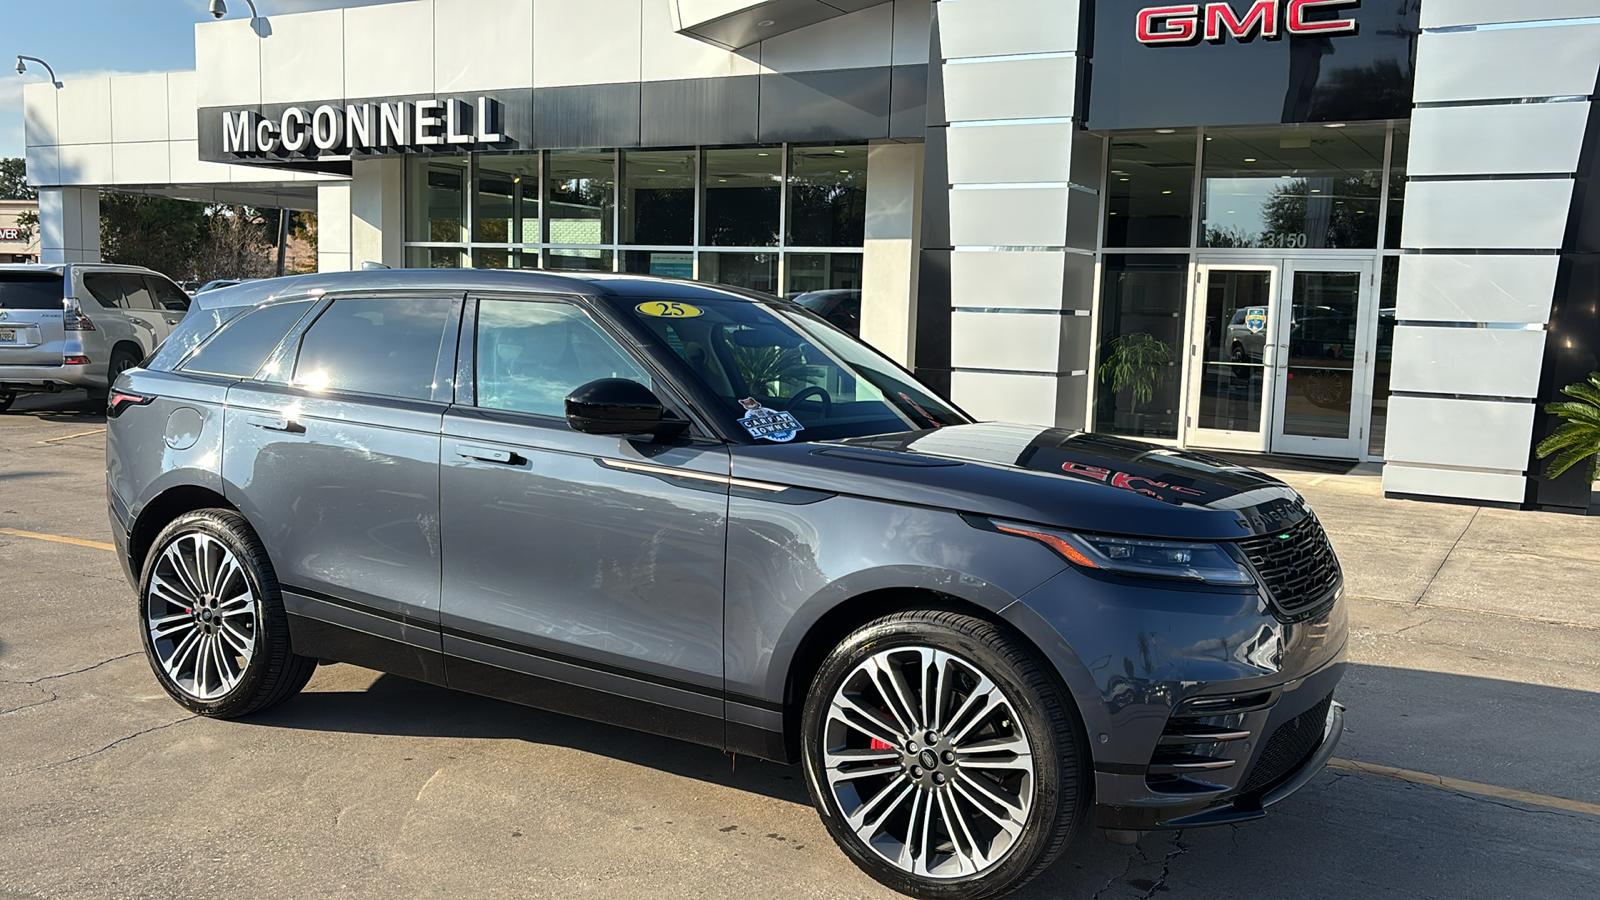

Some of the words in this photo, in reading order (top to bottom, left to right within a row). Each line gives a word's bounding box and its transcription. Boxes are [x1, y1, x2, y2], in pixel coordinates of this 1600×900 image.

[1136, 0, 1355, 43] GMC
[0, 228, 18, 239] VER
[1266, 233, 1307, 248] 3150
[656, 303, 685, 316] 25
[744, 415, 790, 427] CARFAX
[760, 422, 797, 434] OWNER
[1234, 509, 1288, 529] RANGE
